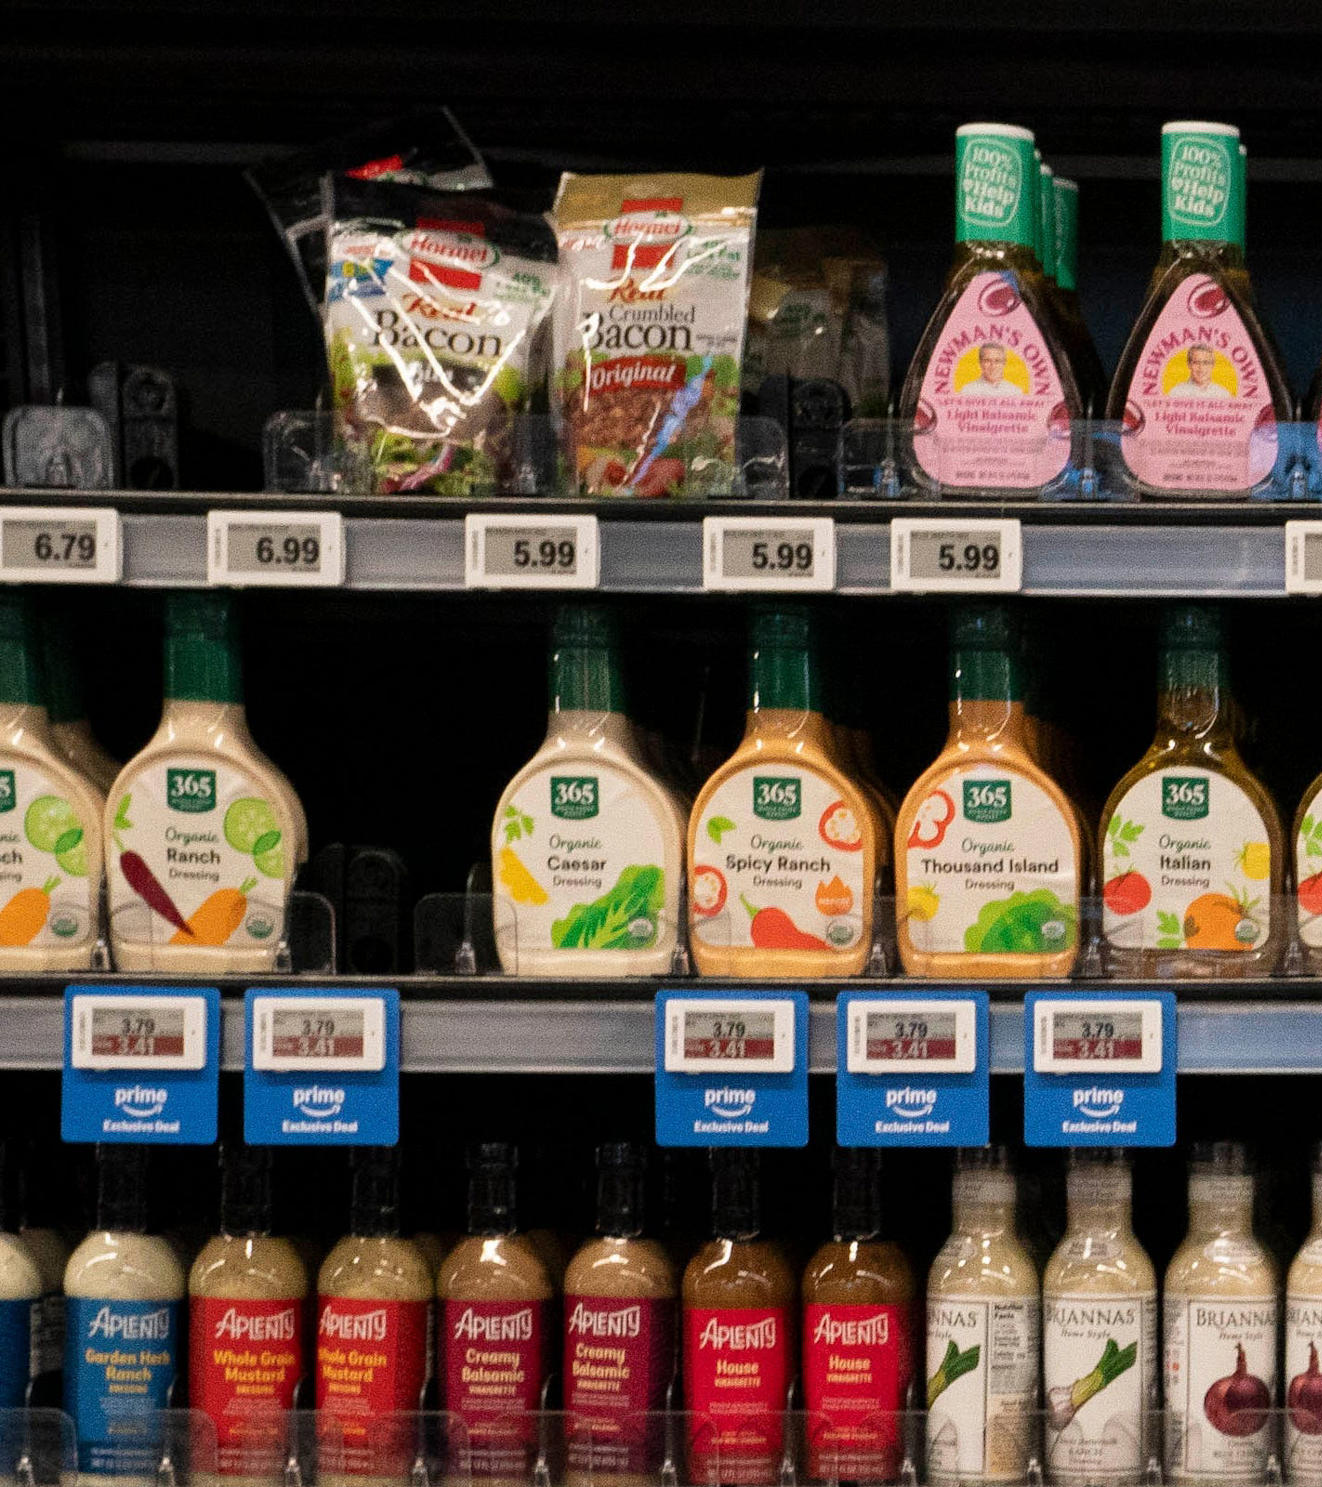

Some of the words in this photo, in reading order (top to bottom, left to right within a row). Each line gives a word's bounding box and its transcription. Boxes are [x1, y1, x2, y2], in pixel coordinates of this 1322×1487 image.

[373, 311, 502, 357] Bacon
[592, 363, 676, 390] Original
[34, 535, 96, 562] 6.79
[256, 538, 319, 565] 6.99
[513, 542, 576, 567] 5.99
[939, 545, 999, 570] 5.99
[171, 775, 211, 798] 365
[555, 782, 593, 804] 365
[756, 783, 796, 804] 365
[750, 835, 802, 851] Organic
[167, 848, 220, 864] Ranch
[547, 856, 606, 872] Caesar
[726, 856, 772, 874] Spicy
[778, 857, 831, 872] Ranch
[1160, 854, 1211, 870] Italian
[921, 858, 1002, 873] Thousand
[1009, 858, 1059, 873] Island
[705, 1089, 755, 1107] prime
[576, 1346, 625, 1364] Creamy
[225, 1367, 285, 1383] Mustard
[717, 1360, 758, 1377] House
